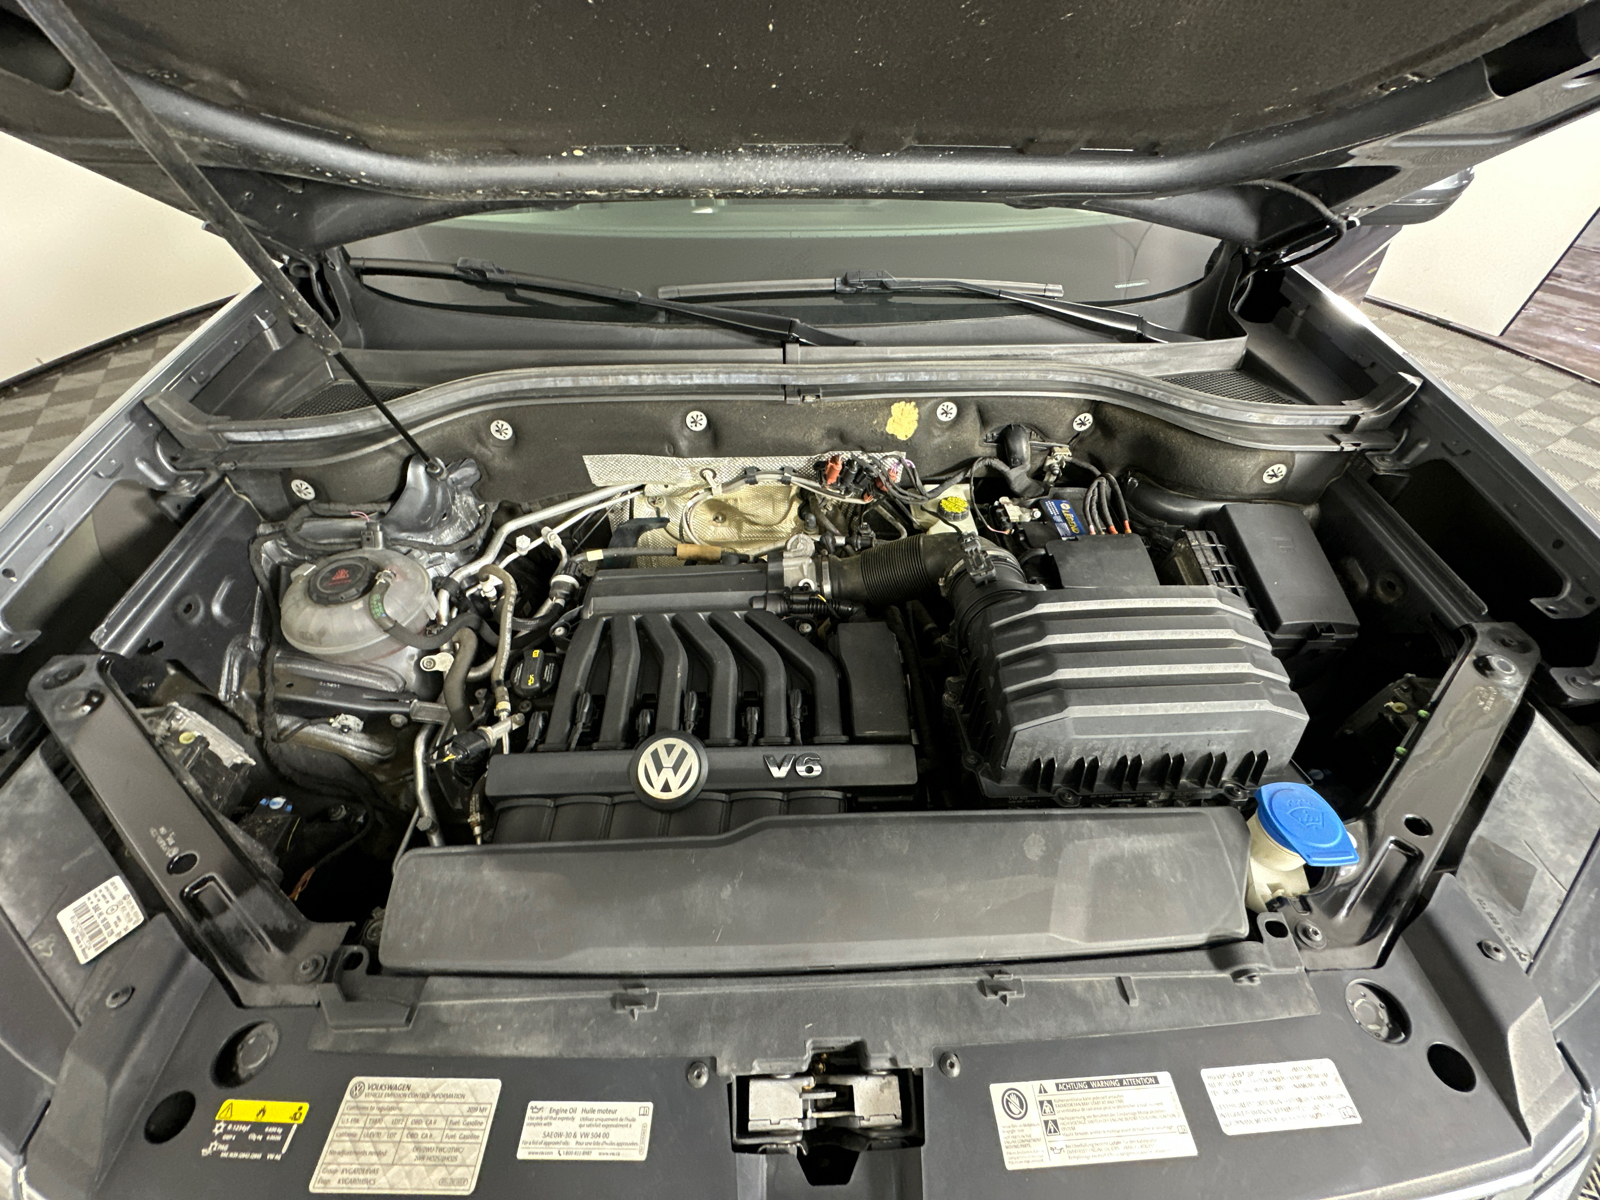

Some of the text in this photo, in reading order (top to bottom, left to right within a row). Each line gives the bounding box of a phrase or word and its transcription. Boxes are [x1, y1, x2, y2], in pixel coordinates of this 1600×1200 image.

[762, 753, 824, 780] V6
[367, 1083, 412, 1091] VOLKSWAGEN
[1058, 1077, 1156, 1091] ACHTUNG WARNING ATTENTION
[549, 1107, 568, 1116] Engine
